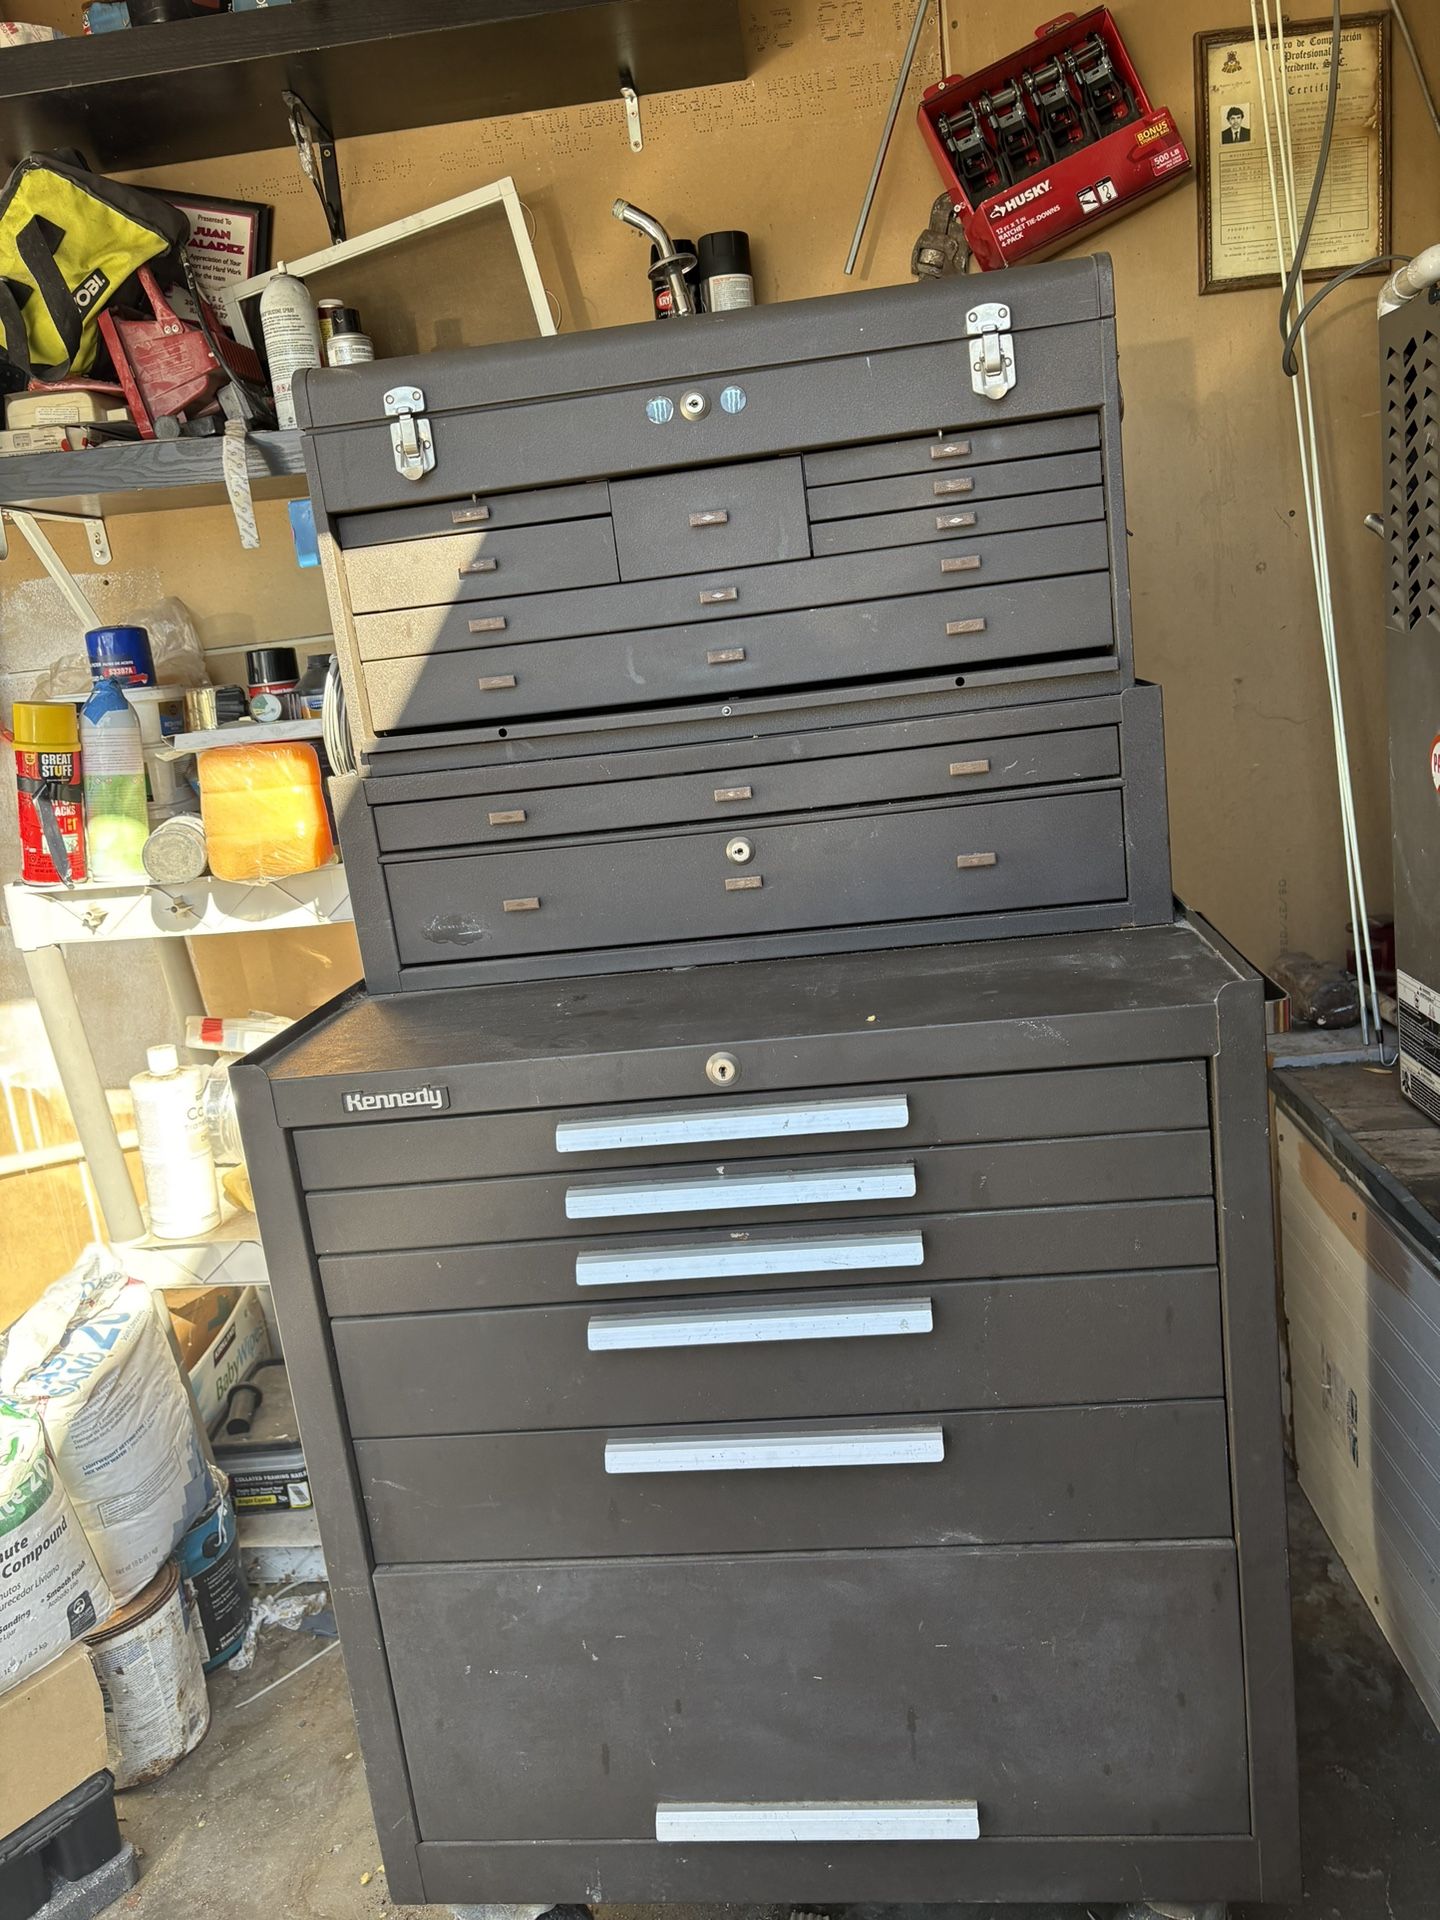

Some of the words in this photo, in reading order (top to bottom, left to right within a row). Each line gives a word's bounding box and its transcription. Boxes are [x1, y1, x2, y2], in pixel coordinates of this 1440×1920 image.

[1296, 39, 1305, 48] de
[1309, 32, 1362, 47] Comptación
[1284, 47, 1331, 62] Profesional
[1288, 83, 1341, 95] Certifia
[1137, 120, 1168, 141] BONUS
[1153, 152, 1169, 165] 500
[1170, 148, 1180, 157] LB
[1004, 179, 1050, 212] HUSKY
[197, 214, 224, 224] Presented
[225, 218, 232, 226] To
[998, 223, 1026, 242] RATCHET
[1026, 204, 1061, 227] TIE-DOWNS
[193, 226, 231, 241] JUAN
[996, 227, 1004, 235] 12
[1003, 224, 1010, 232] FT
[1001, 232, 1024, 248] 4-PACK
[213, 265, 226, 273] Hard
[226, 267, 242, 276] Work
[229, 259, 242, 267] Your
[41, 753, 72, 765] GREAT
[42, 765, 72, 777] STUFF
[54, 805, 76, 817] ACKS
[346, 1087, 443, 1112] Kennedy
[49, 1353, 105, 1398] SAND
[29, 1458, 49, 1487] 20
[2, 1514, 68, 1579] Compound
[35, 1562, 60, 1593] Liviano
[46, 1575, 72, 1602] Smooth
[71, 1559, 87, 1582] Finish
